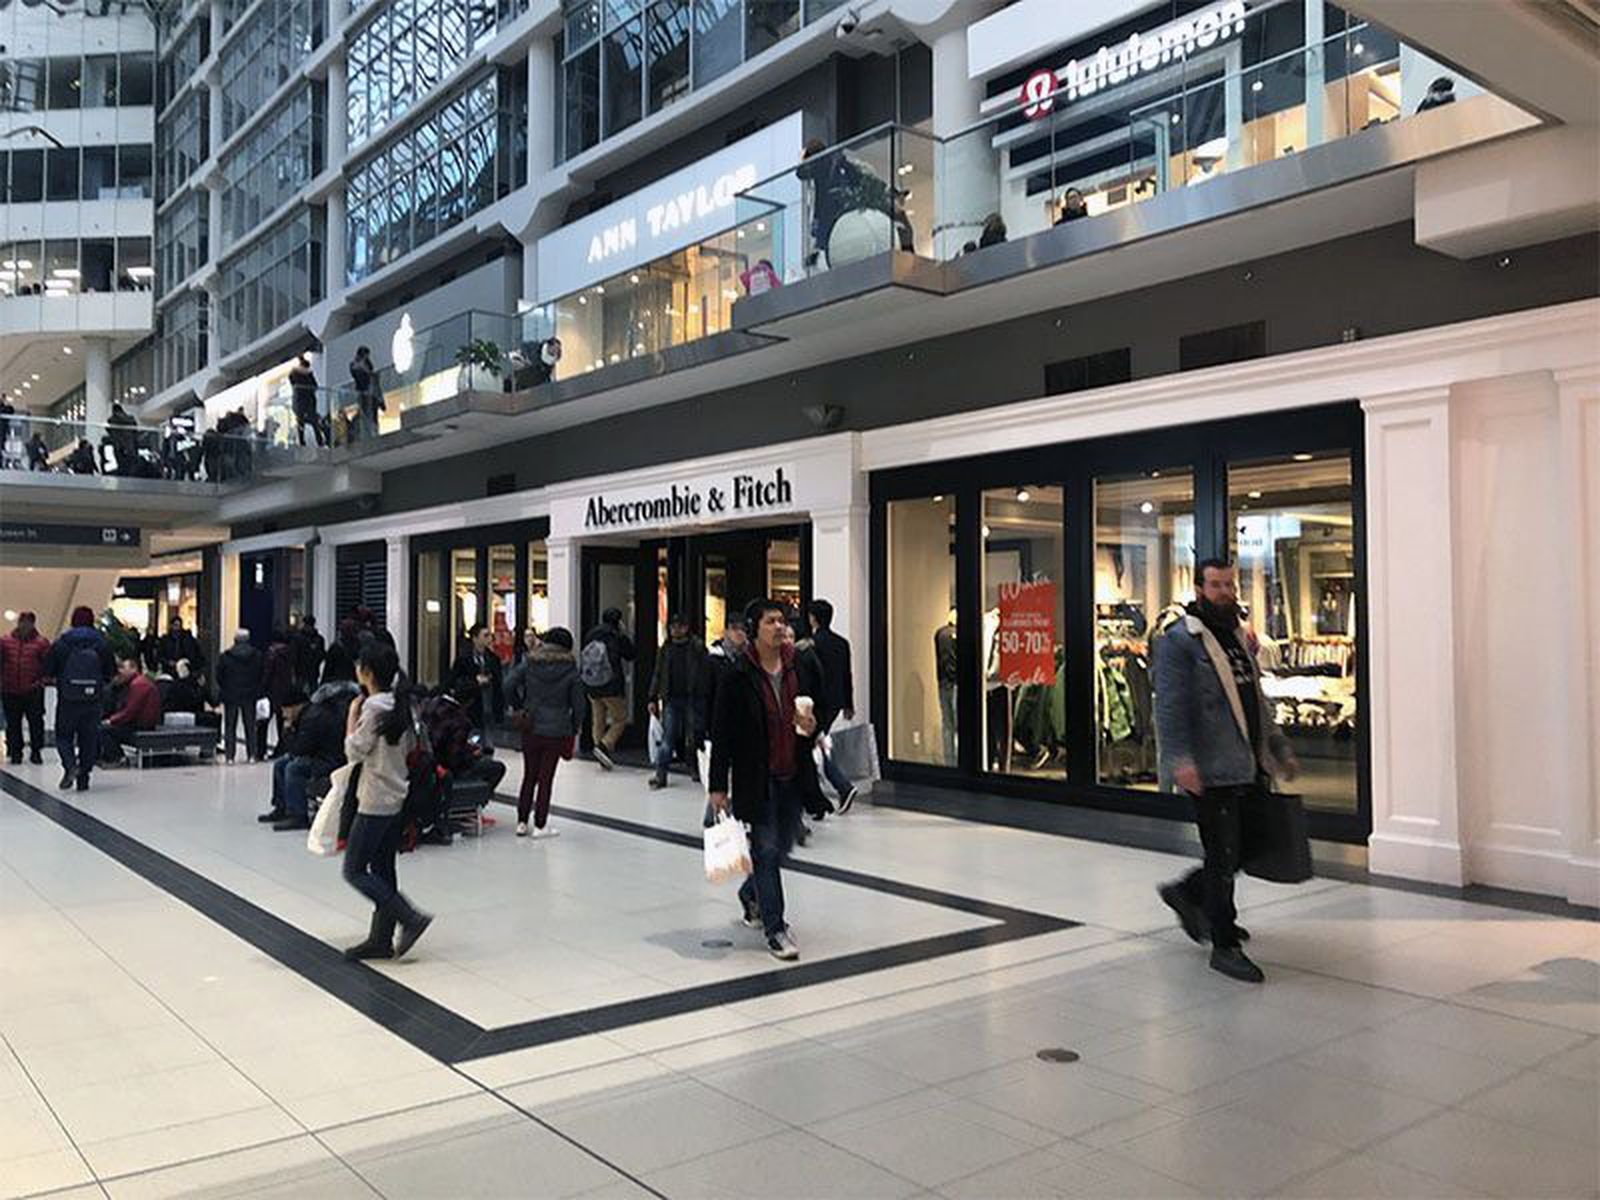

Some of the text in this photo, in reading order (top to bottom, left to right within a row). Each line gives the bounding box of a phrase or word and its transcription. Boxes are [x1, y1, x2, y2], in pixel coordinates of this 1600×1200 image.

[1066, 1, 1246, 101] lululemon
[587, 164, 757, 264] ANN TAYLOR
[585, 466, 792, 527] Abercrombie & Fitch
